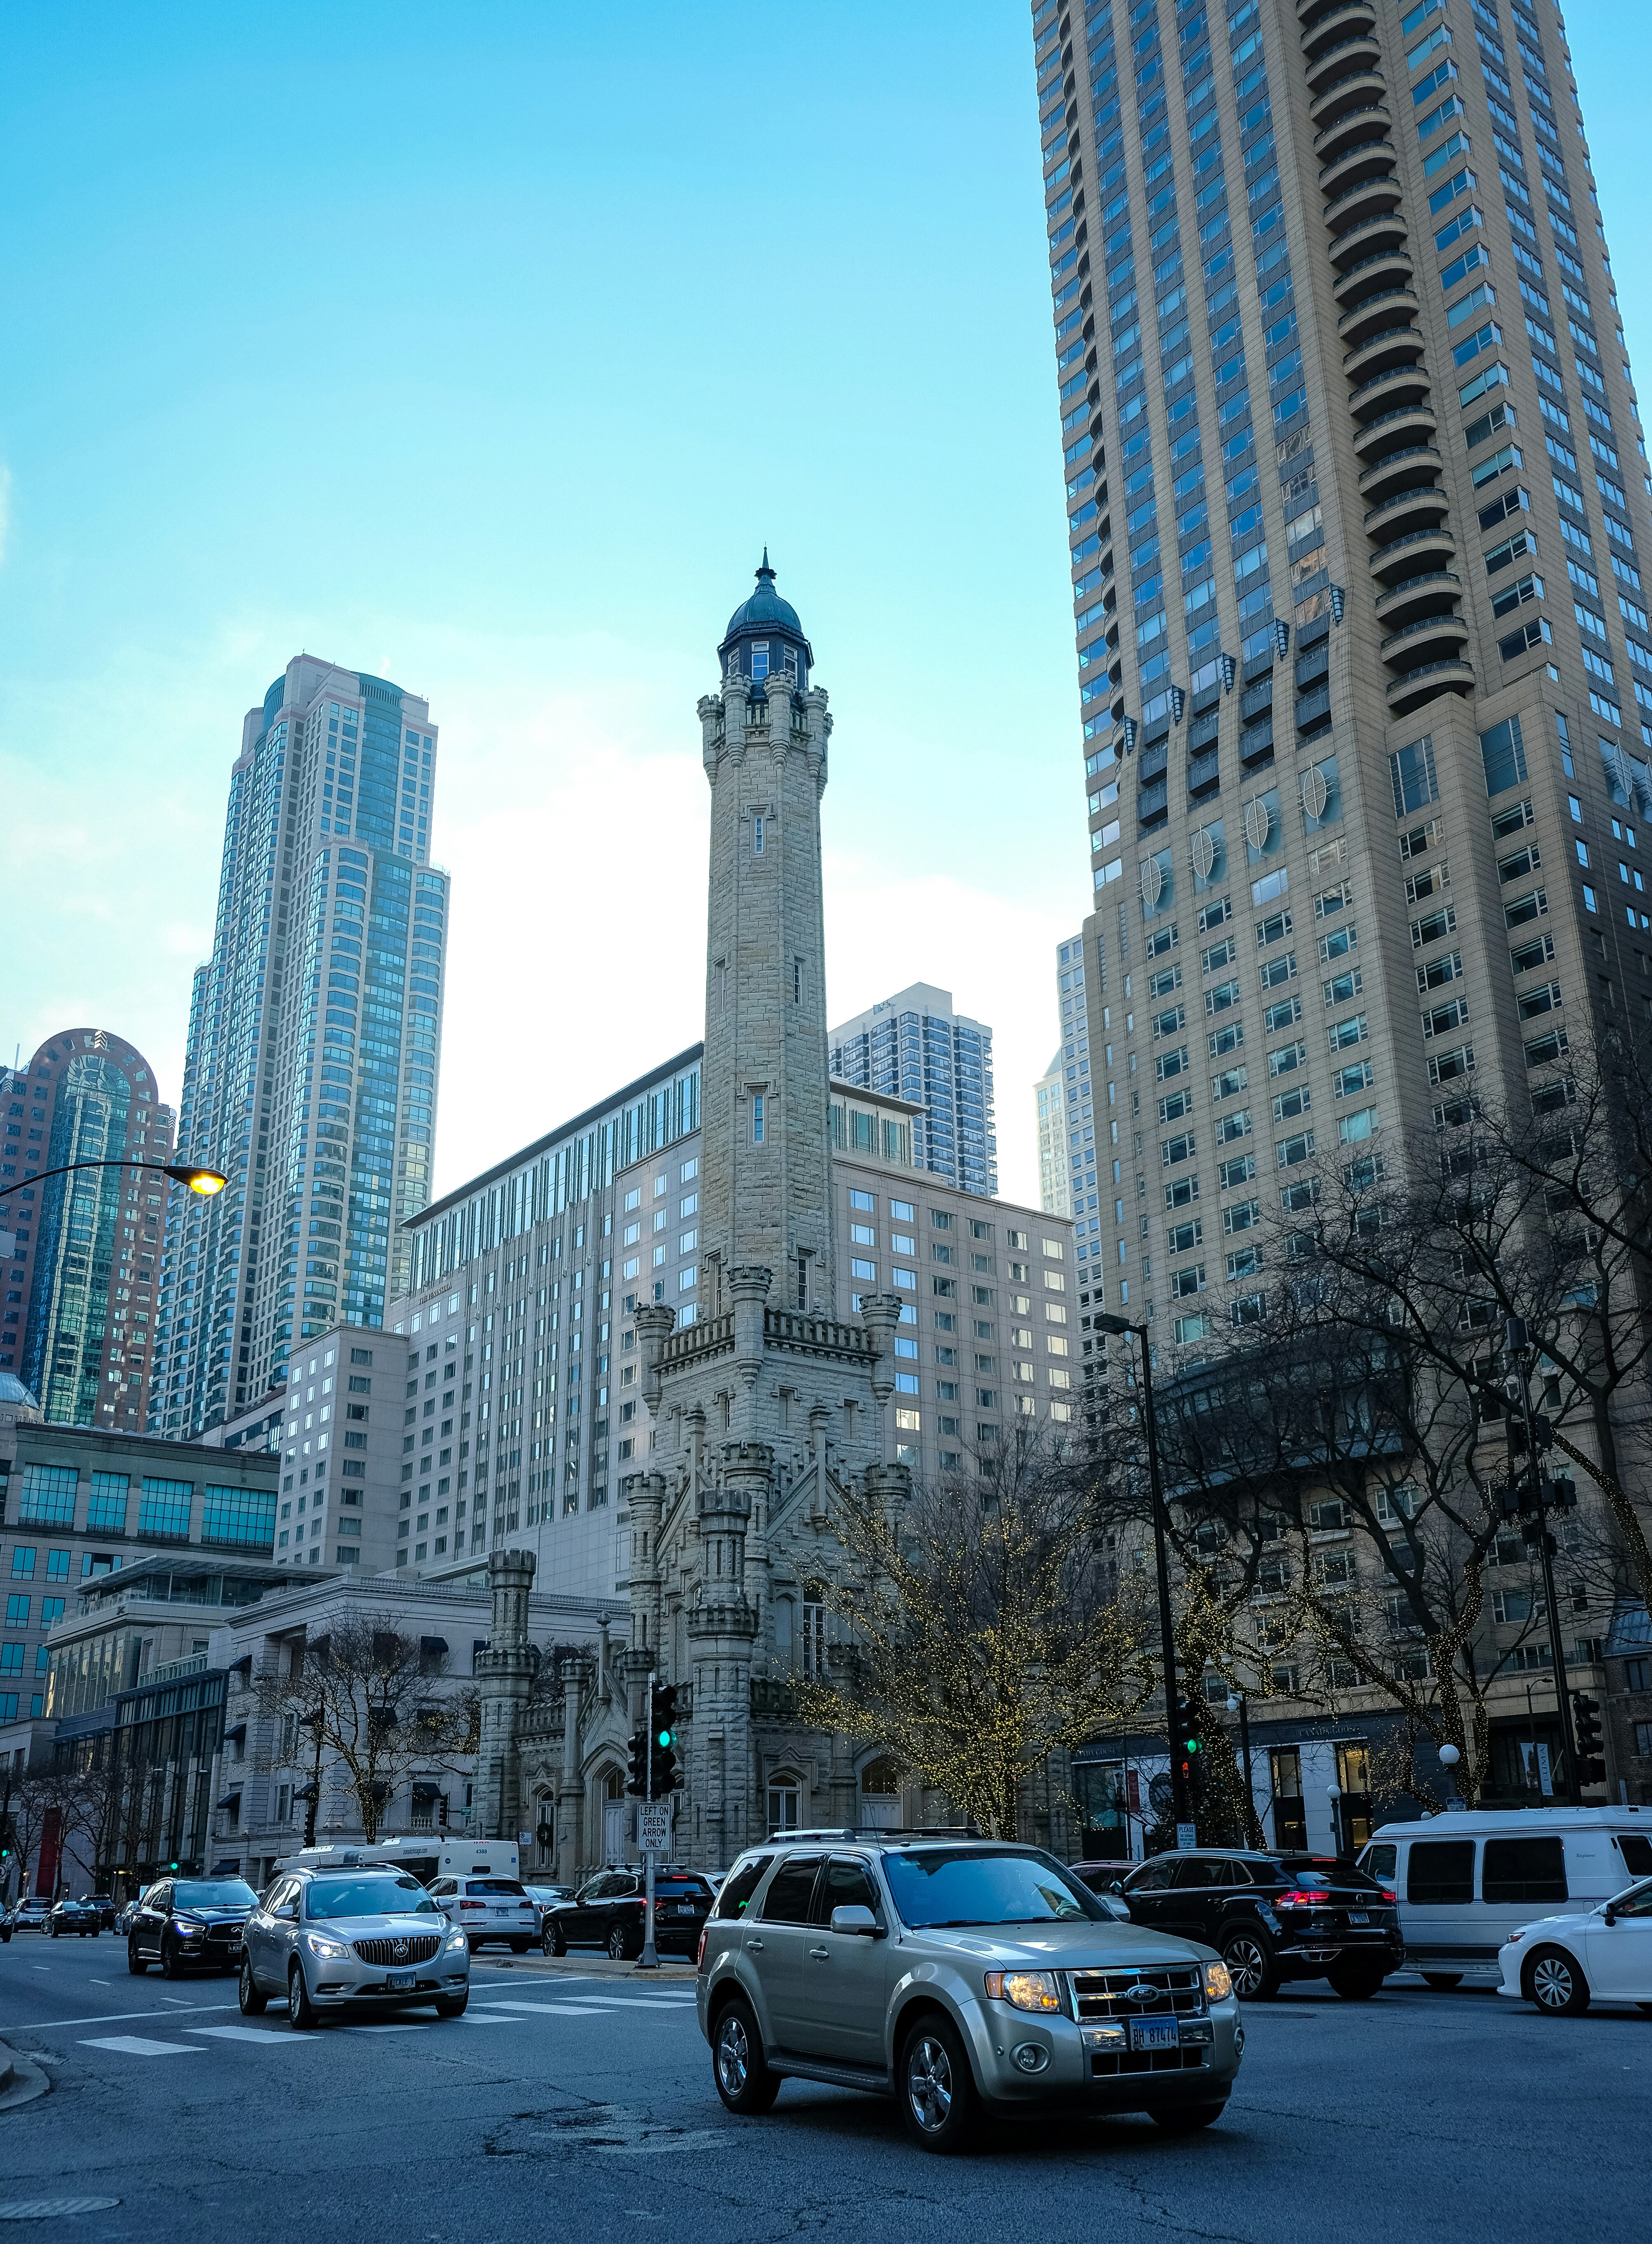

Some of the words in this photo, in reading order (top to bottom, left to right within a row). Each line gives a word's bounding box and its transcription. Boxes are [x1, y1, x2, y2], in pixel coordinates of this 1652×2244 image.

[1300, 1728, 1329, 1736] CANADA
[1332, 1724, 1359, 1734] GOOSE
[641, 1807, 657, 1815] LEFT
[660, 1807, 668, 1815] ON
[643, 1817, 665, 1826] GREEN
[642, 1828, 666, 1837] ARROW
[646, 1839, 662, 1847] ONLY
[1137, 1990, 1152, 1998] Ford
[1133, 2028, 1144, 2044] BH
[1149, 2026, 1176, 2043] 87474
